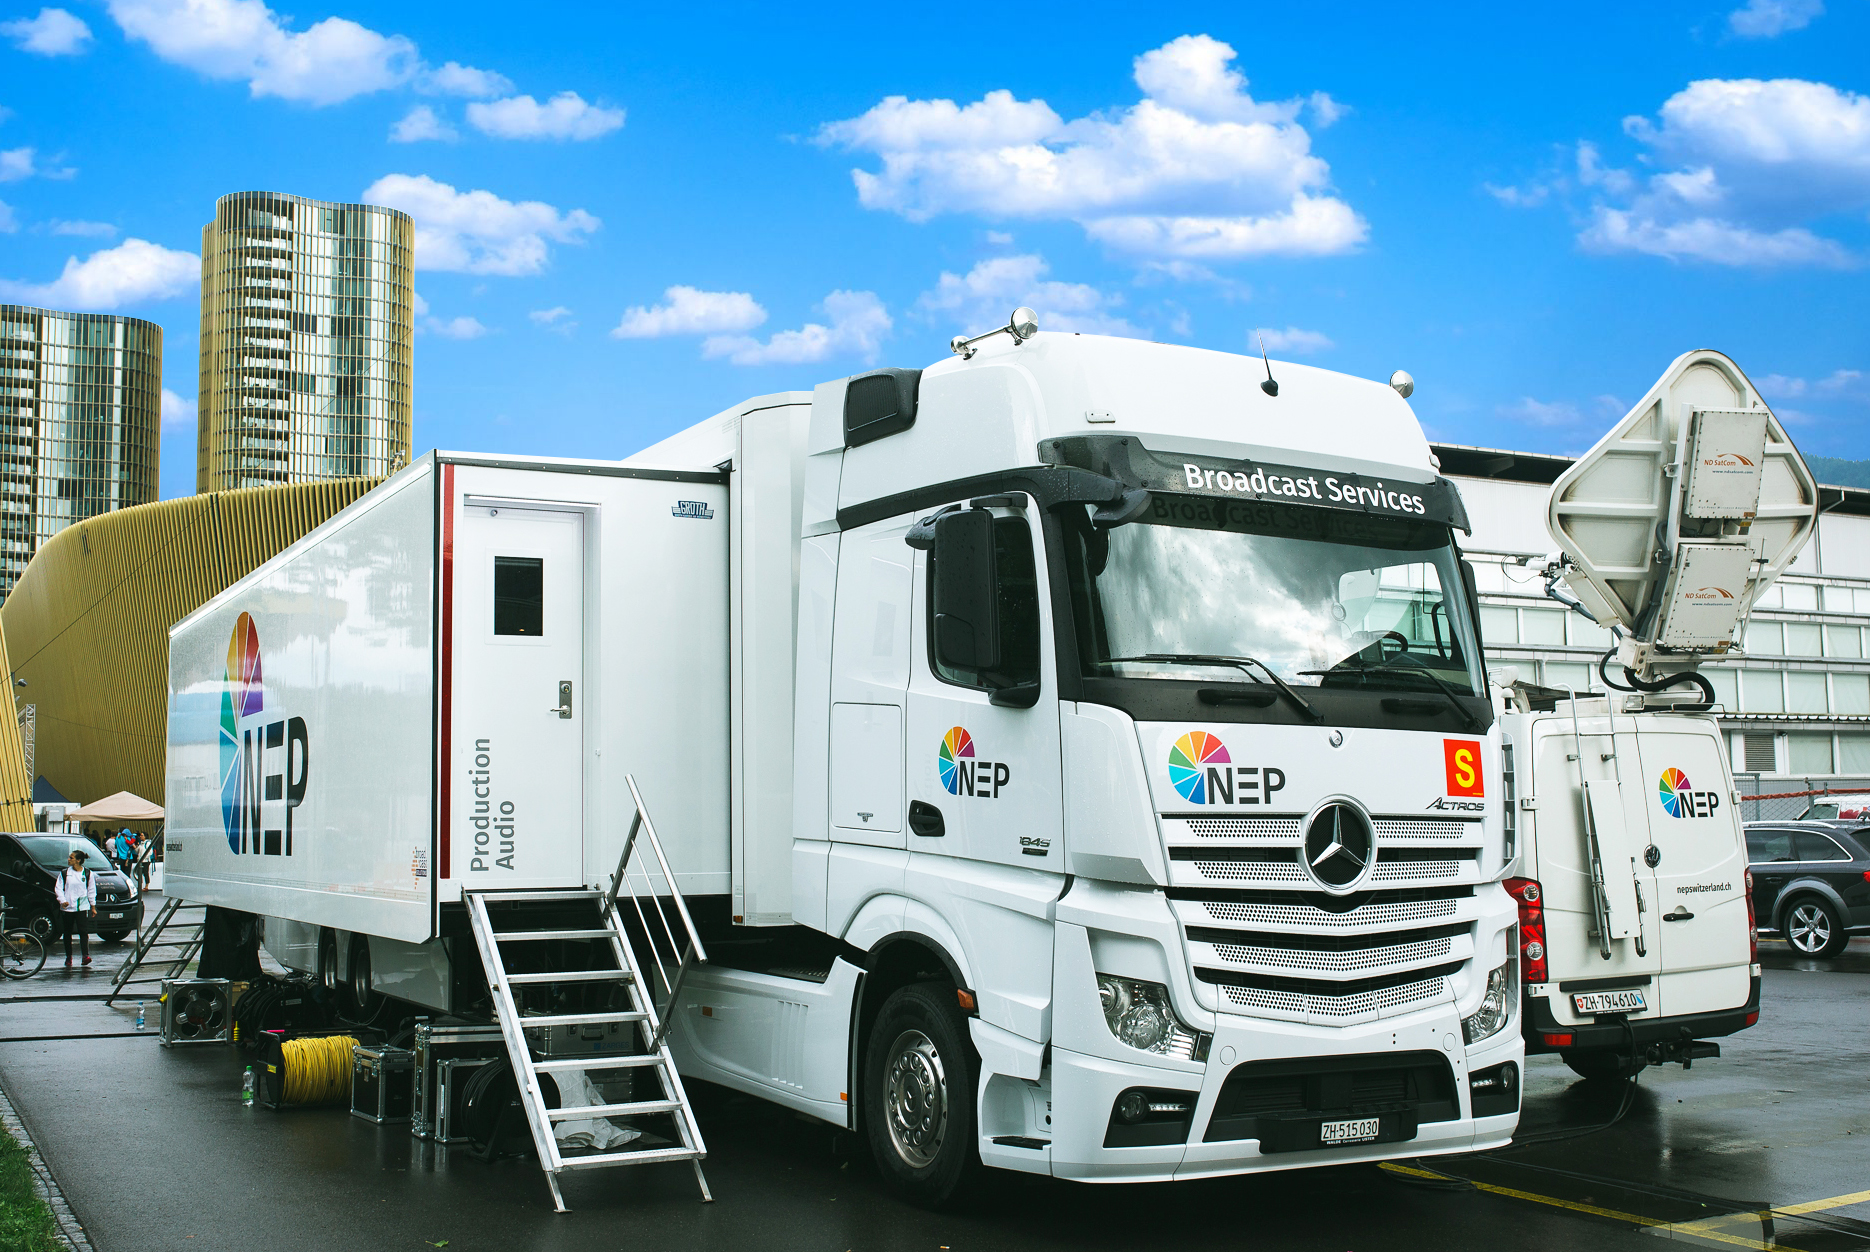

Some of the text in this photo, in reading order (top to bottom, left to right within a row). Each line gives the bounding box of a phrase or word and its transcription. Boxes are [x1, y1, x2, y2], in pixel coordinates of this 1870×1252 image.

[1714, 459, 1736, 467] SatCom
[1183, 463, 1426, 515] Broadcast Services
[680, 501, 706, 516] GROTH
[1694, 592, 1717, 600] SatCom
[241, 716, 309, 856] NEP
[958, 760, 1010, 799] NEP
[1207, 767, 1286, 805] NEP
[1454, 748, 1476, 788] S
[468, 738, 490, 872] Production
[1679, 791, 1720, 818] NEP
[493, 800, 515, 871] Audio
[1676, 881, 1732, 896] nepswitzerland.ch
